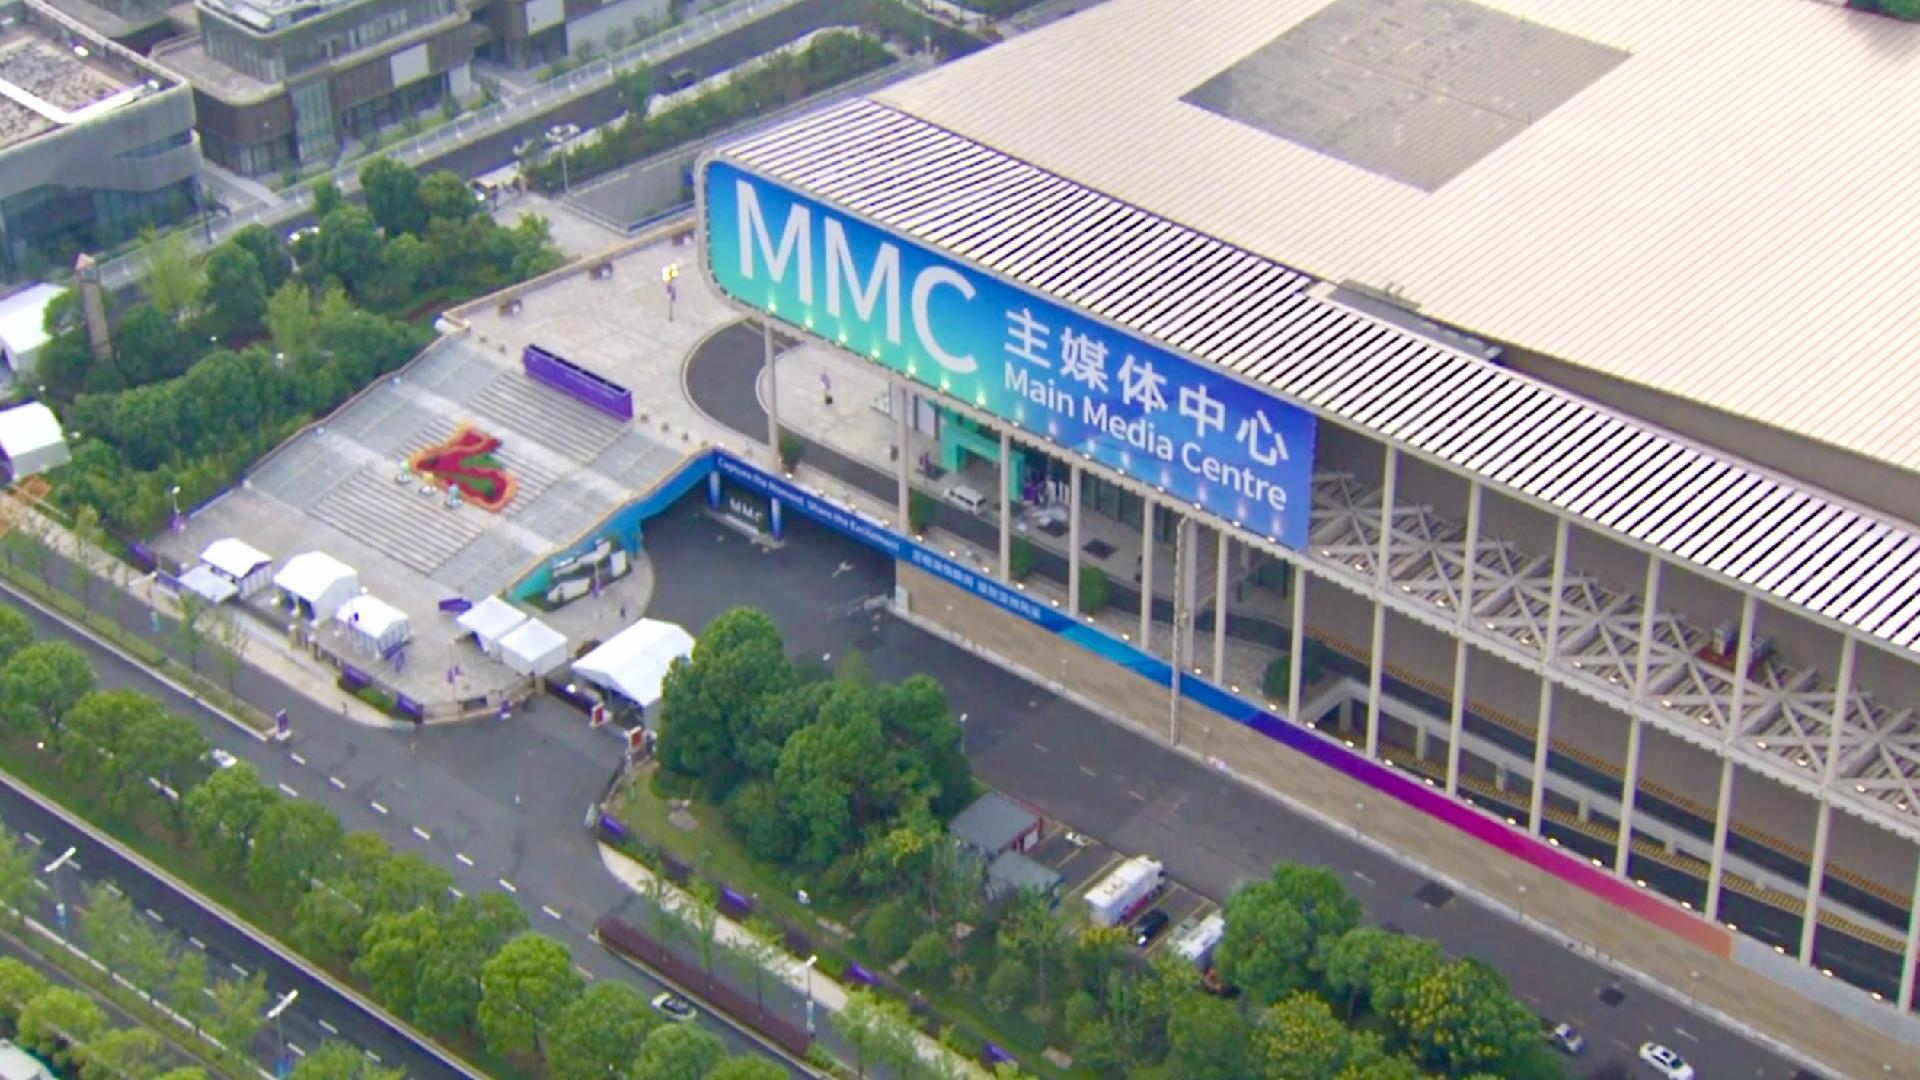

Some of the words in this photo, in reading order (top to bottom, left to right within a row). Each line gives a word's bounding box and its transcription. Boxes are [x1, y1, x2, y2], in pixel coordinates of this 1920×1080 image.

[738, 181, 978, 374] MMC
[1004, 362, 1074, 417] Main
[1083, 396, 1174, 461] Media
[1181, 442, 1287, 513] Centre
[1007, 309, 1288, 466] 主媒体中心
